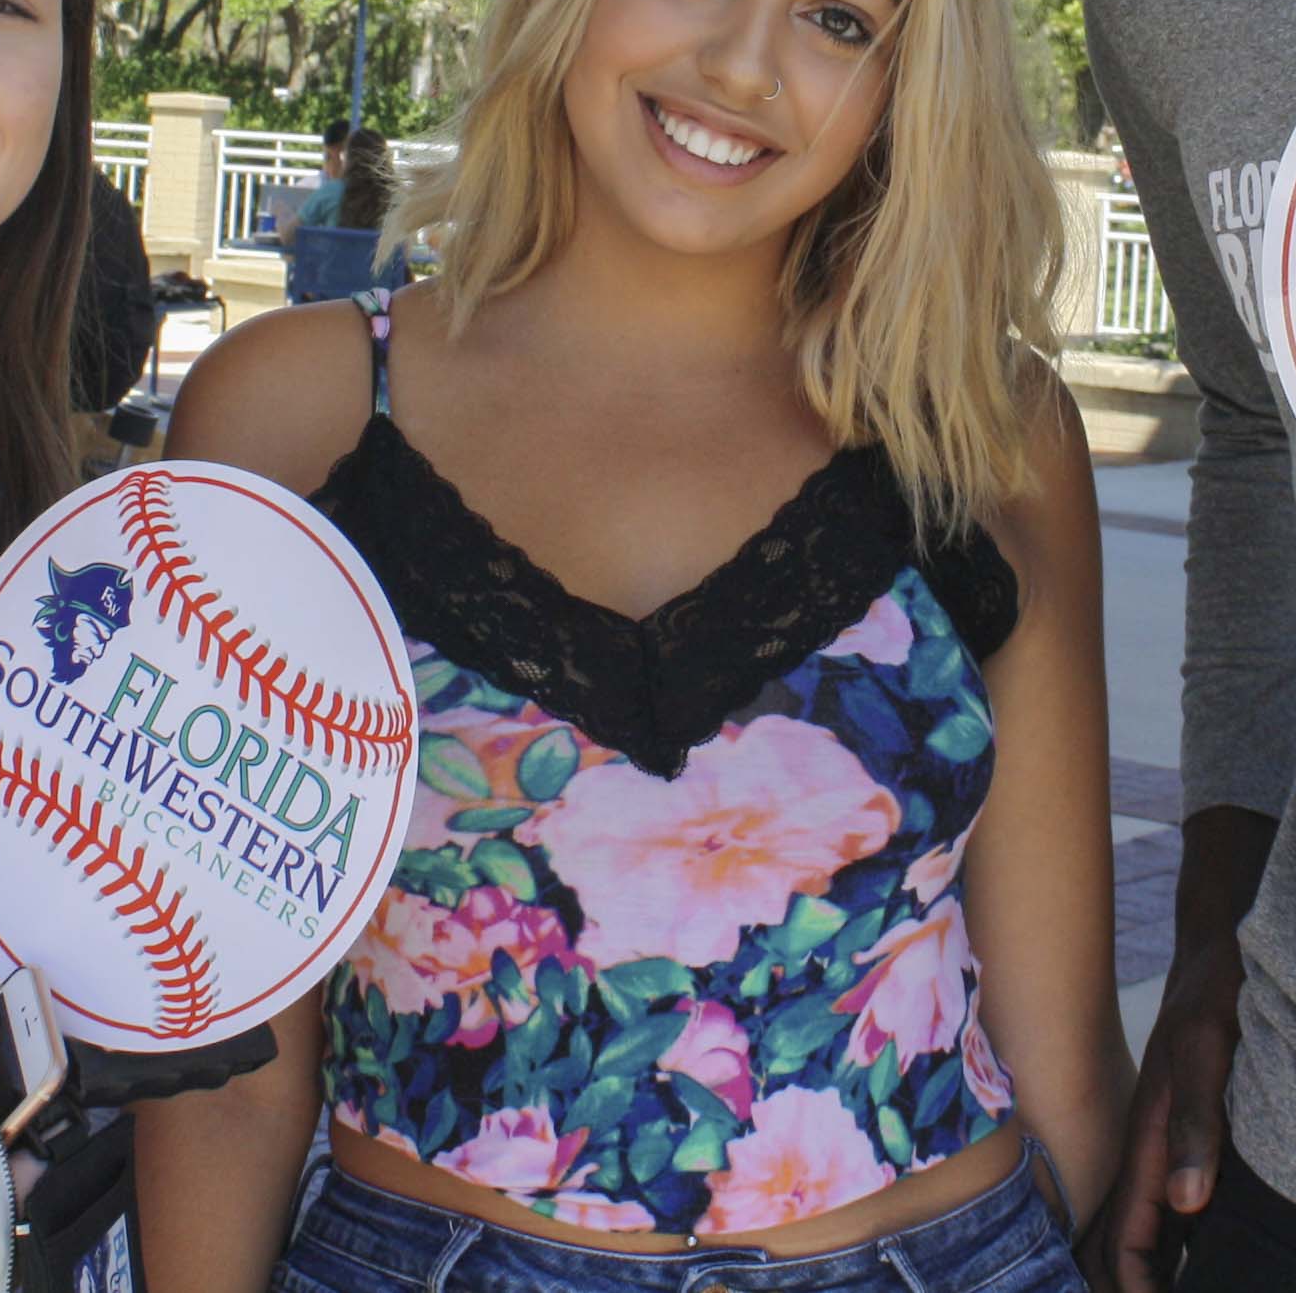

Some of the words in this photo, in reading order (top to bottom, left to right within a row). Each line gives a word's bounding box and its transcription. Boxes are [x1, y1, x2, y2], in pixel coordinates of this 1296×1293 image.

[100, 585, 122, 617] FSW
[101, 652, 362, 876] FLORIDA
[97, 778, 320, 940] BUCCANEERS
